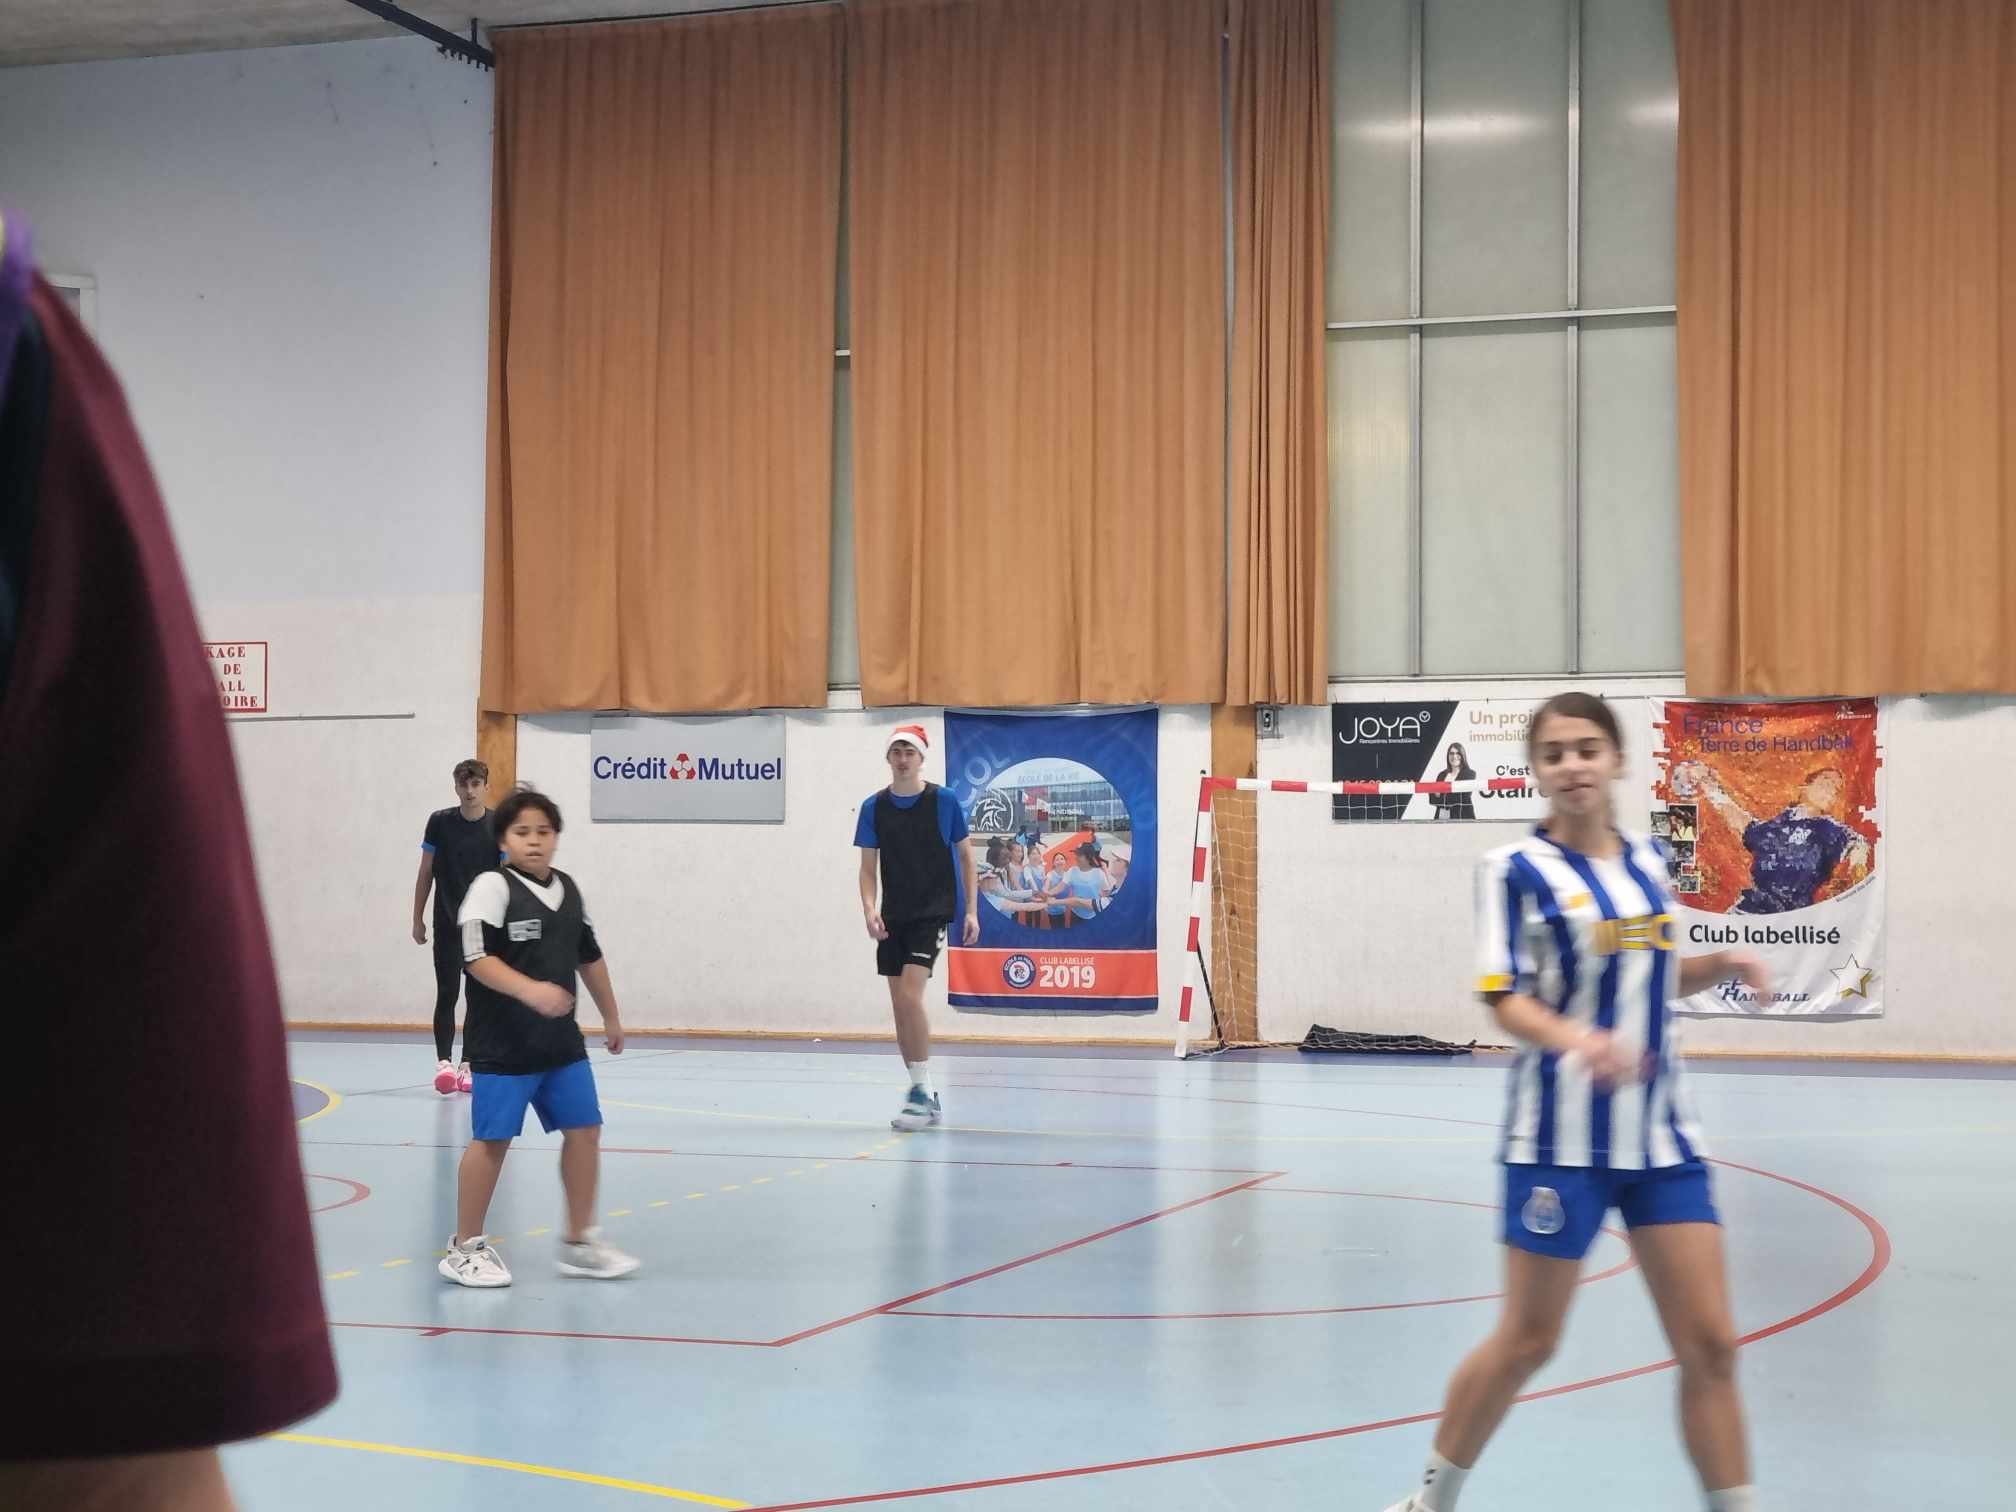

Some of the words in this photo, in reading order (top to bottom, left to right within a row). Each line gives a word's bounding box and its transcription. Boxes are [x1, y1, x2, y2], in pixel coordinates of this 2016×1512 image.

[223, 664, 241, 675] DE
[223, 695, 258, 707] OIRE
[1470, 711, 1494, 725] Un
[1684, 712, 1763, 735] France
[1339, 716, 1420, 744] JOYA
[1697, 736, 1740, 753] Terre
[1744, 736, 1767, 752] de
[593, 756, 667, 780] Crédit
[698, 757, 781, 780] Mutuel
[1496, 764, 1531, 776] C'est
[1689, 923, 1739, 944] Club
[1744, 923, 1841, 945] labellisé
[1040, 956, 1058, 965] CLUB
[1040, 965, 1096, 989] 2019
[1721, 988, 1810, 1002] HANBALL
